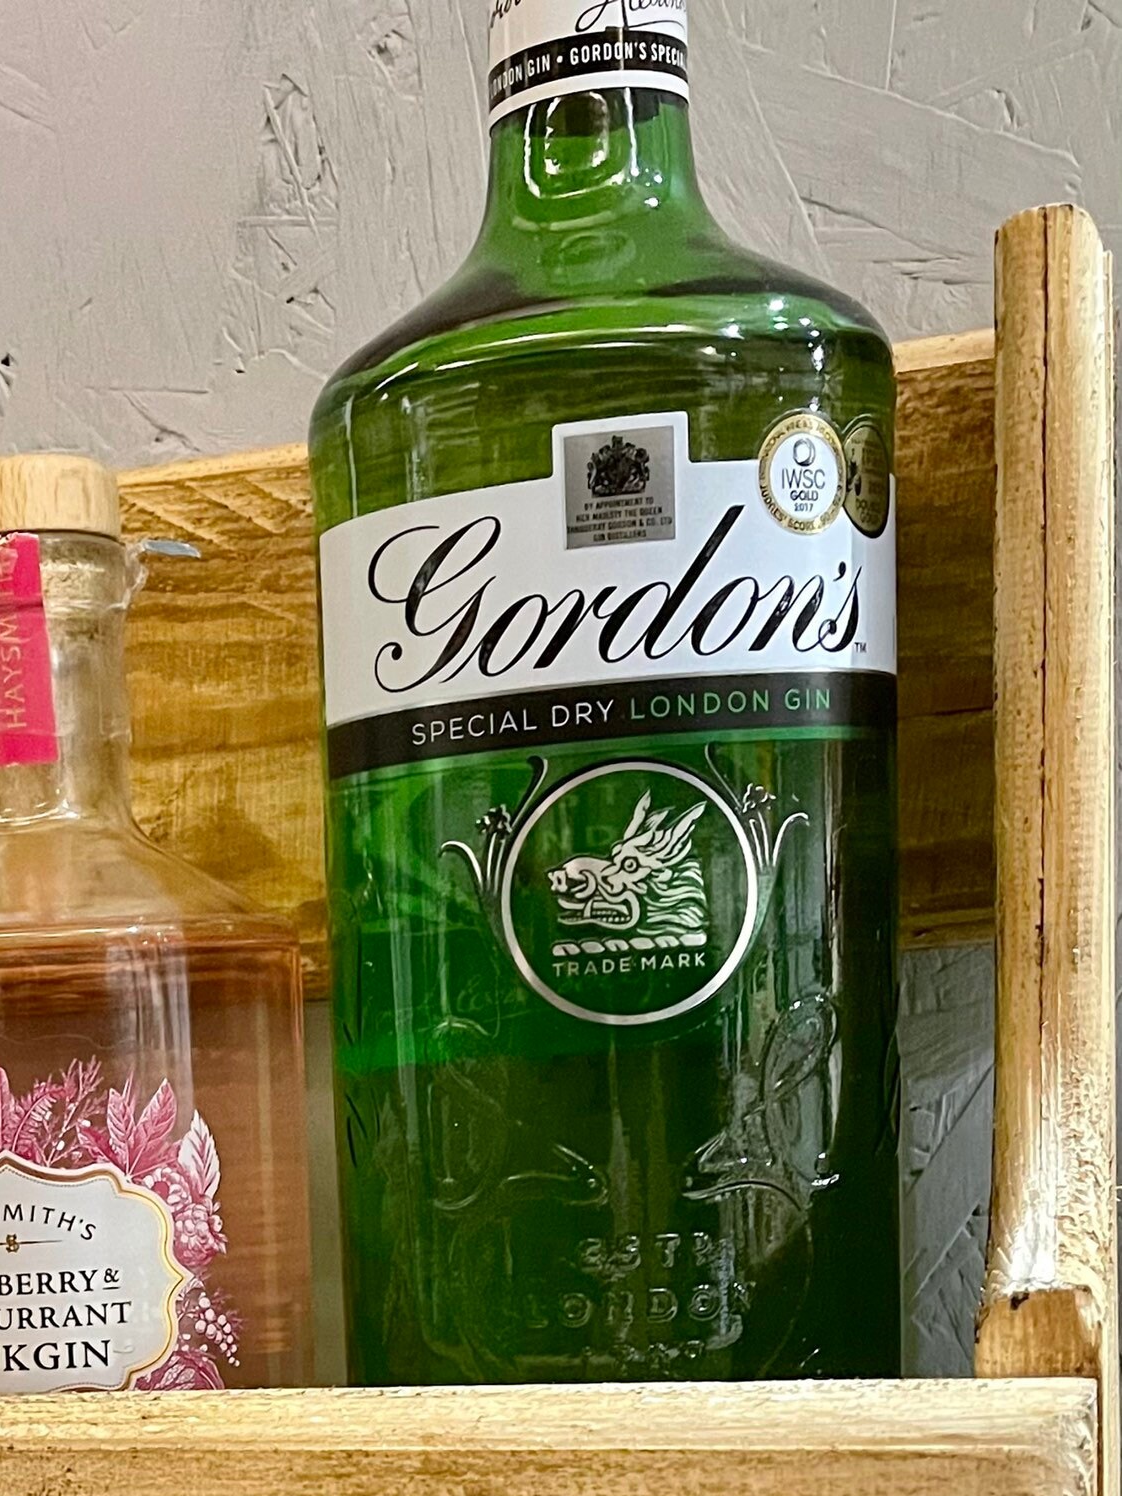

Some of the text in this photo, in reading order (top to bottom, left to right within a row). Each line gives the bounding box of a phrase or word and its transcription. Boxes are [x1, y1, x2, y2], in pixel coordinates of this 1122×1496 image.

[527, 53, 551, 77] GIN
[570, 41, 647, 66] GORDON'S
[781, 468, 826, 489] IWSC
[790, 490, 819, 501] GOLD
[367, 504, 865, 693] Gordon's
[411, 687, 832, 746] SPECIAL DRY LONDON GIN
[552, 952, 706, 977] TRADE MARK
[102, 1267, 121, 1291] &
